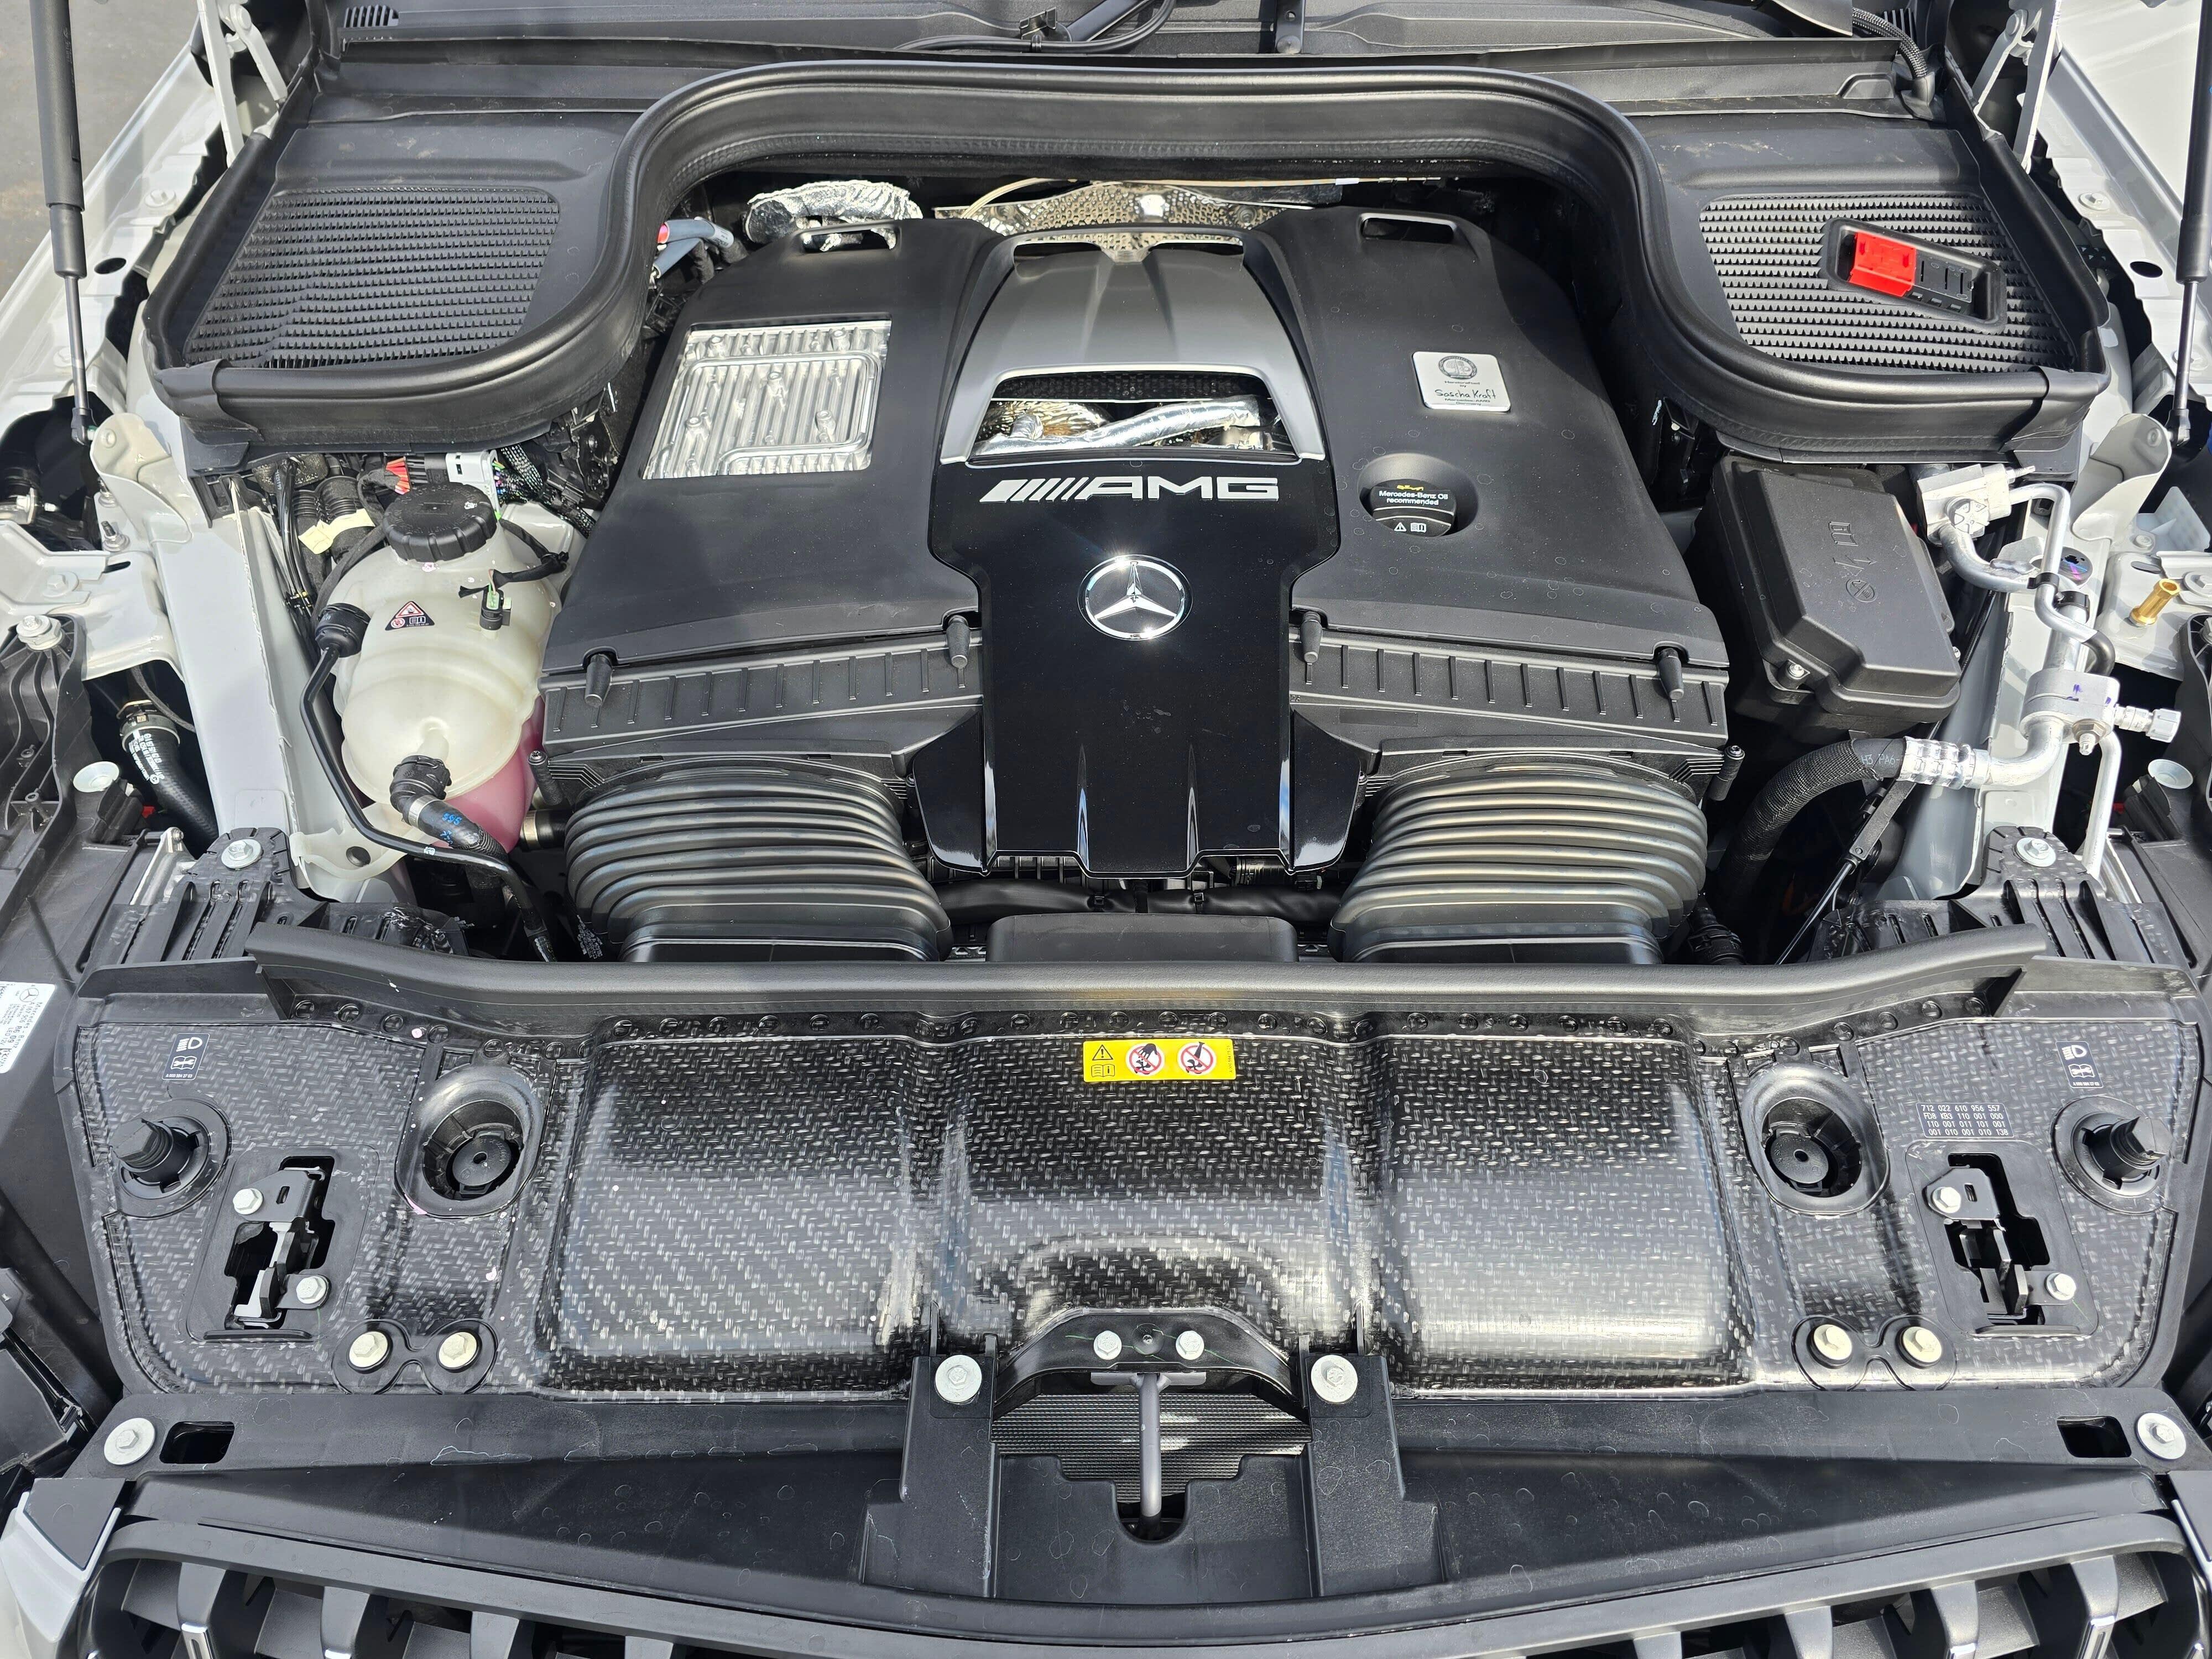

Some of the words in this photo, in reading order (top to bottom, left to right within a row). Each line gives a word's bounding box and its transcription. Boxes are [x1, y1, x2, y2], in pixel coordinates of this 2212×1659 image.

[1434, 389, 1470, 398] Sascha
[1472, 389, 1496, 399] Kraft
[1074, 476, 1279, 501] AMG
[1379, 491, 1437, 499] Mercedes-Benz
[1386, 497, 1439, 505] recommended
